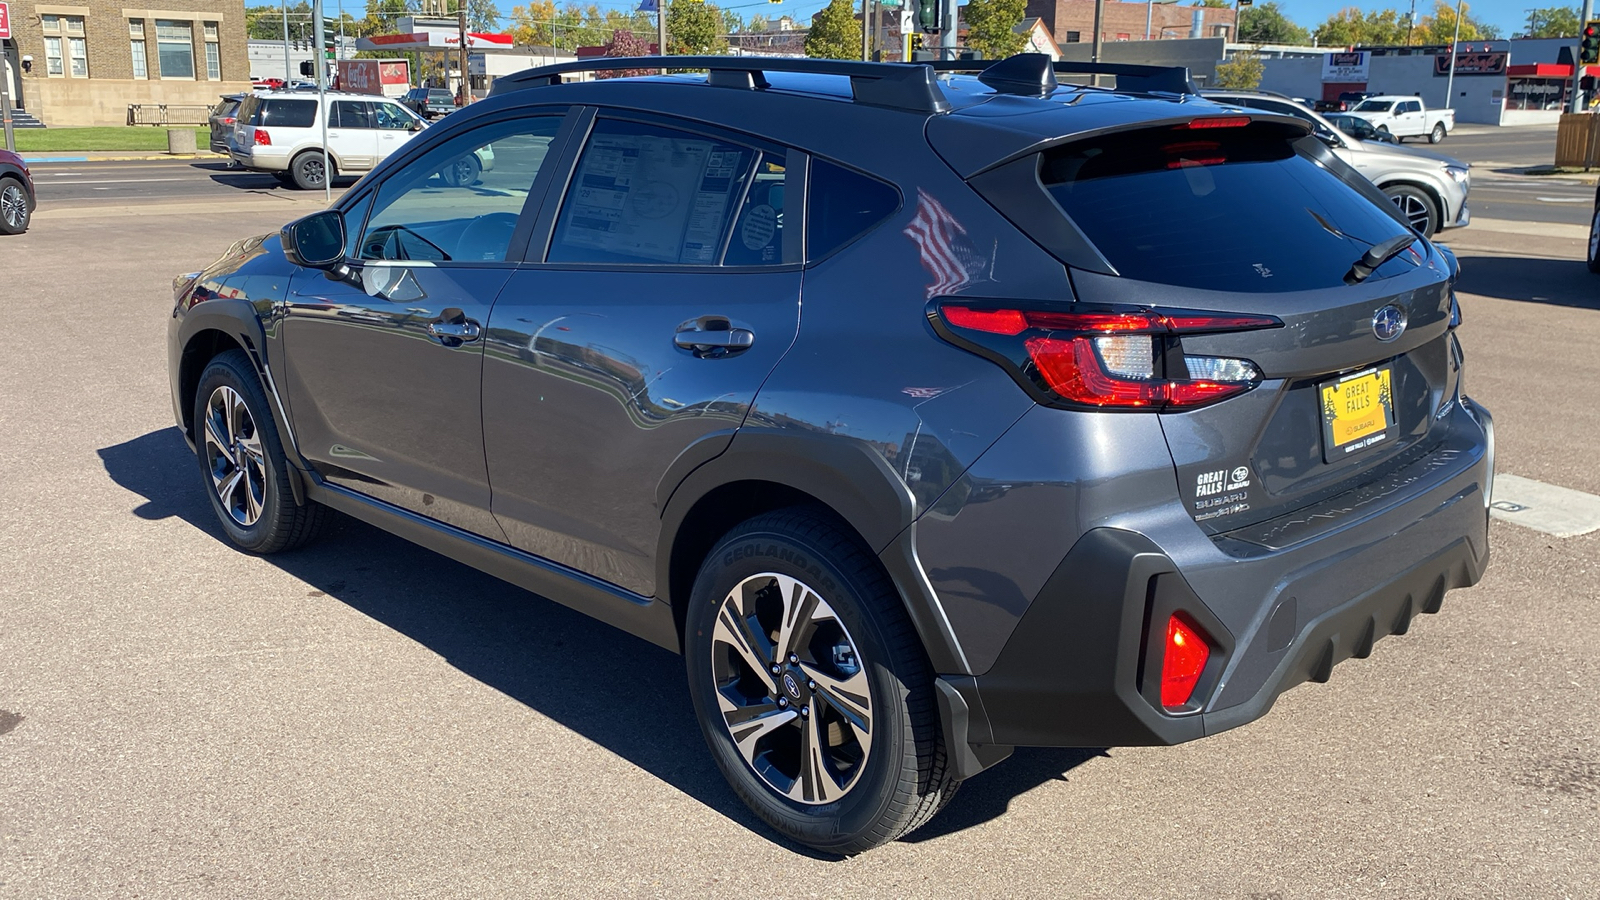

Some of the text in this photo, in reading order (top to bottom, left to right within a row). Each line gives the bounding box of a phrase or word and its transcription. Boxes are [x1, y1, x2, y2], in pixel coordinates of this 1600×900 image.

[1346, 381, 1369, 399] GREAT
[1346, 395, 1370, 414] FALLS
[1353, 420, 1375, 433] SUBARU
[1197, 470, 1224, 485] GREAT
[1227, 480, 1250, 491] SUBARU
[1196, 482, 1223, 497] FALLS
[1196, 491, 1248, 509] SUBARU
[723, 543, 837, 591] GEOLANDAR
